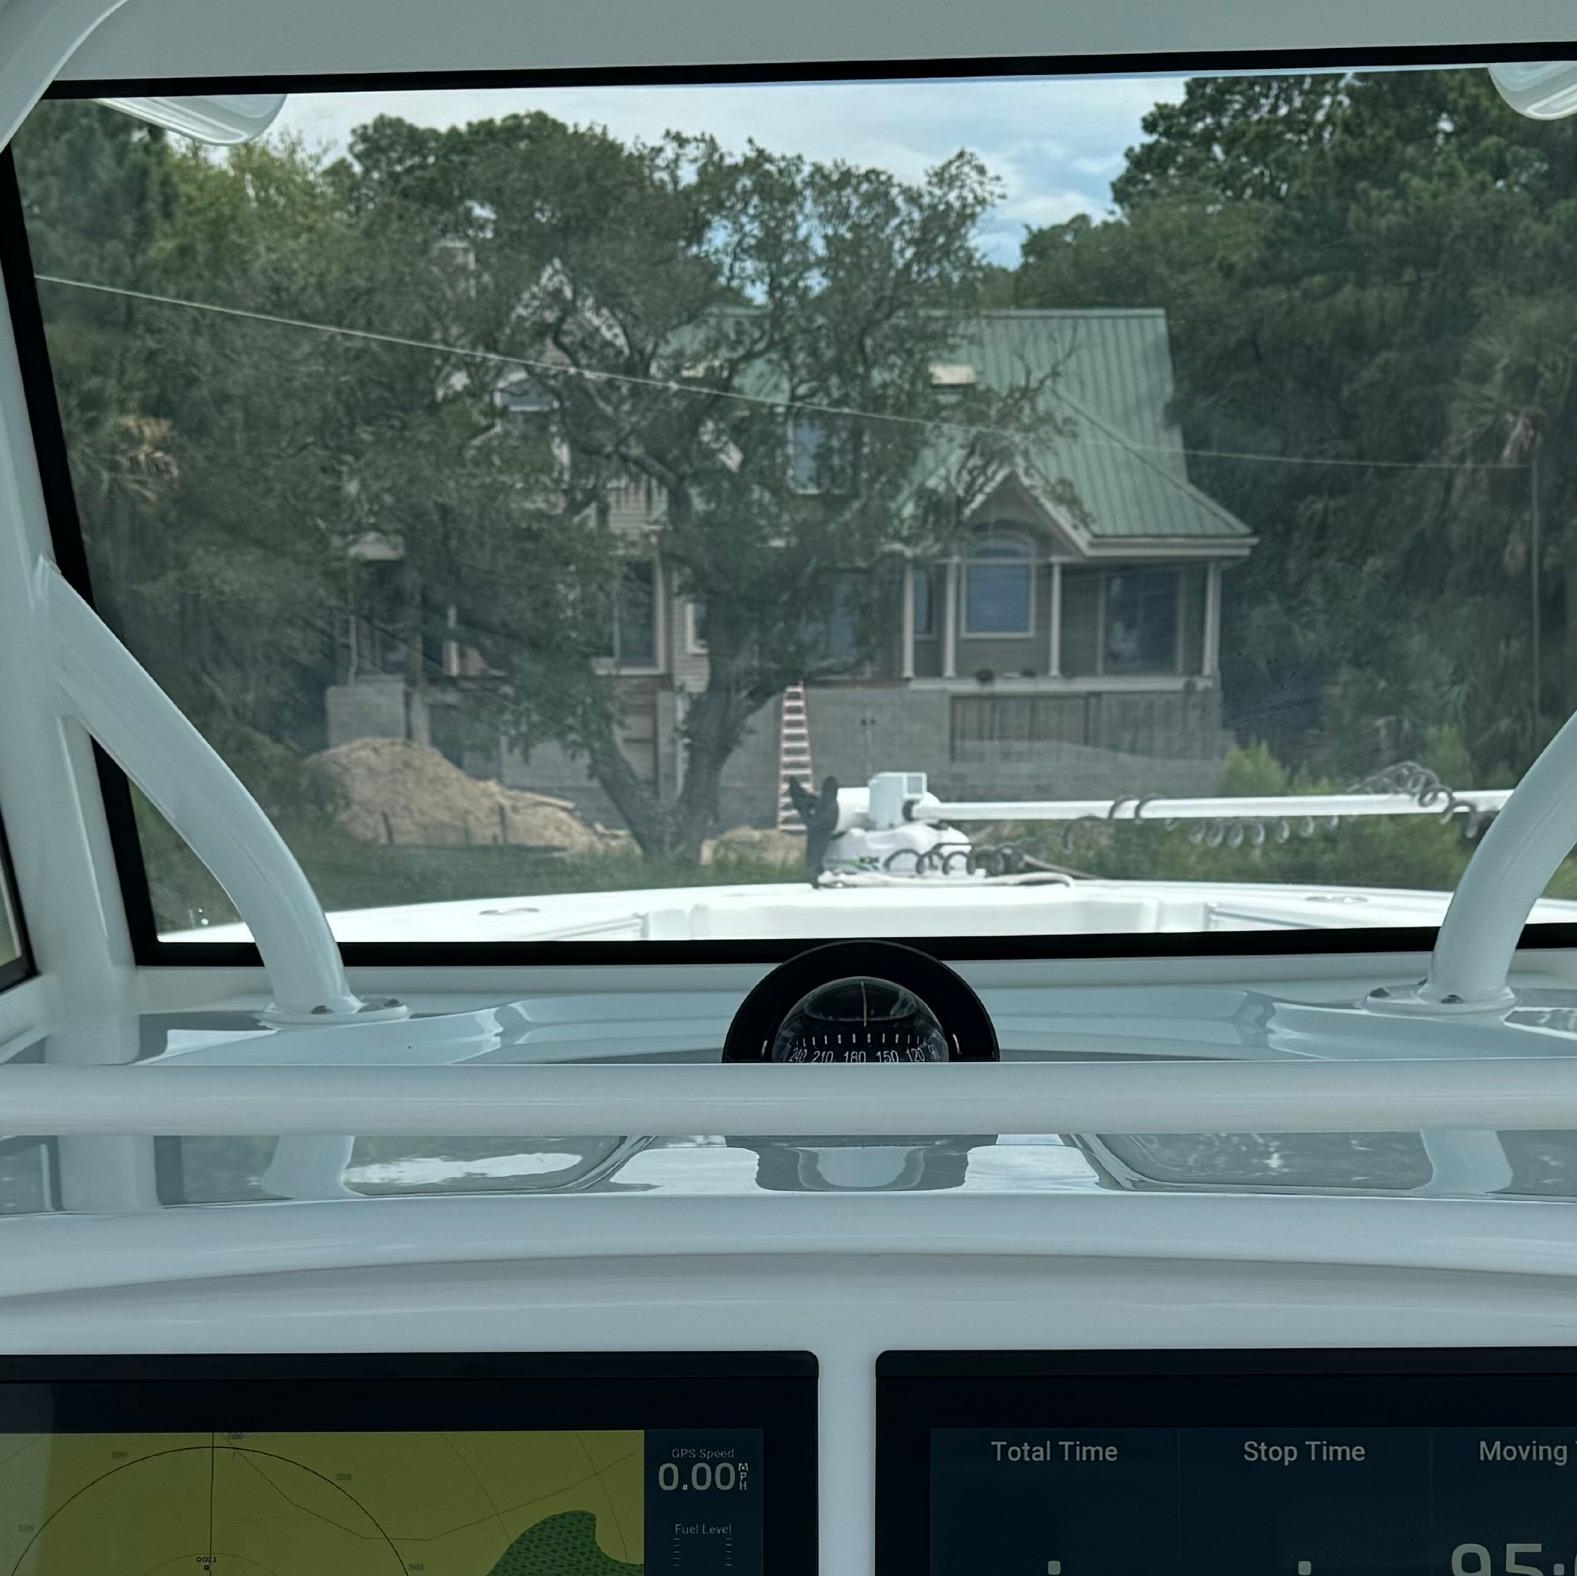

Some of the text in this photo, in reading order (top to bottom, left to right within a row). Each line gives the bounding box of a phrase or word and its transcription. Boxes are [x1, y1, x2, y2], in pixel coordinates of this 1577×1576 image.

[812, 1051, 834, 1063] 210
[843, 1051, 867, 1063] 180
[875, 1050, 899, 1063] 150
[905, 1047, 926, 1062] 120
[699, 1448, 734, 1461] Speed
[991, 1442, 1118, 1461] Total Time
[1244, 1441, 1366, 1465] Stop Time
[1480, 1441, 1568, 1465] Moving
[658, 1462, 736, 1491] 0.00
[675, 1524, 732, 1535] Fuel Level
